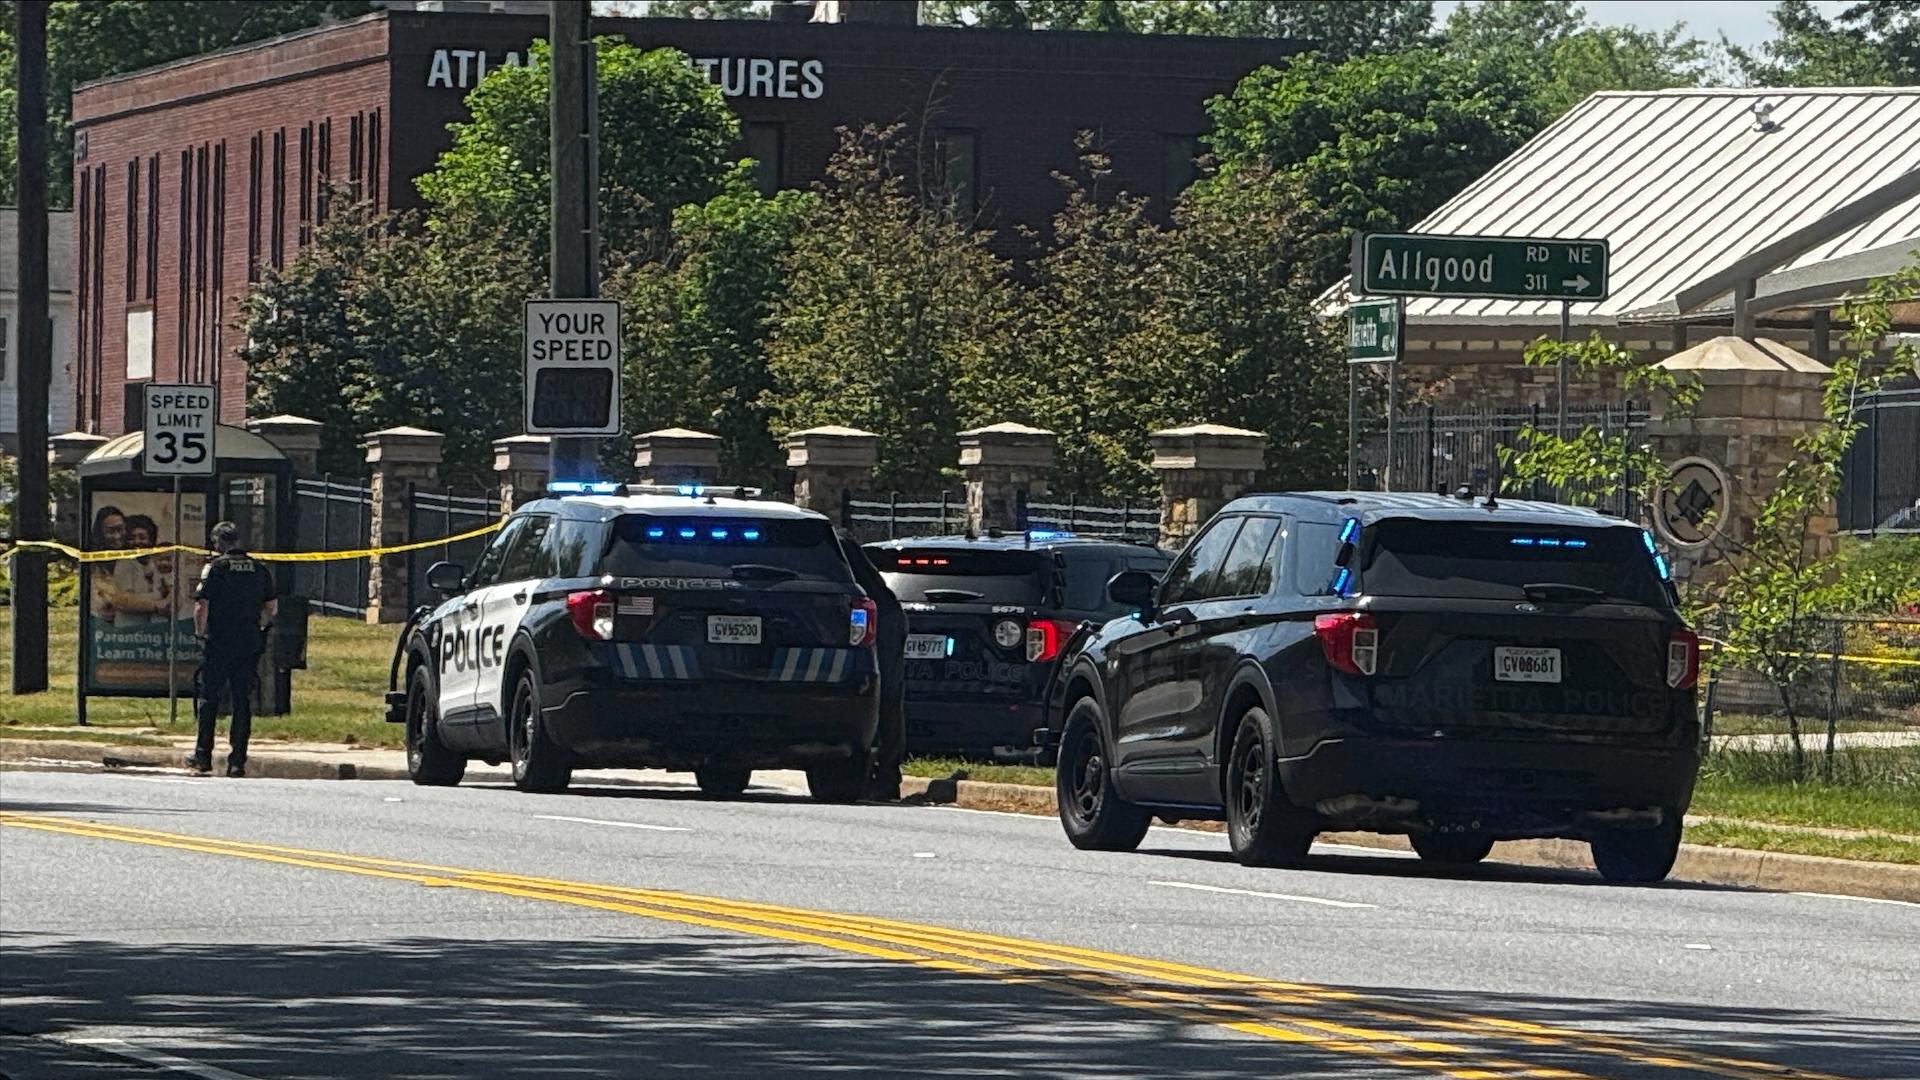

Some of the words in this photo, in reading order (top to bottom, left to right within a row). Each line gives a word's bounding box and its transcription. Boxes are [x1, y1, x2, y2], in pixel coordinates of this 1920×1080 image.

[1526, 246, 1550, 263] RD
[1568, 247, 1593, 264] NE
[1378, 249, 1493, 291] Allgood
[1524, 273, 1548, 291] 311
[538, 312, 605, 335] YOUR
[532, 339, 612, 361] SPEED
[151, 394, 210, 409] SPEED
[157, 413, 203, 428] LIMIT
[152, 431, 207, 464] 35
[620, 576, 724, 591] POLICE
[95, 630, 162, 646] Parenting
[96, 647, 136, 660] Learn
[137, 647, 162, 660] The
[440, 624, 505, 675] POLICE
